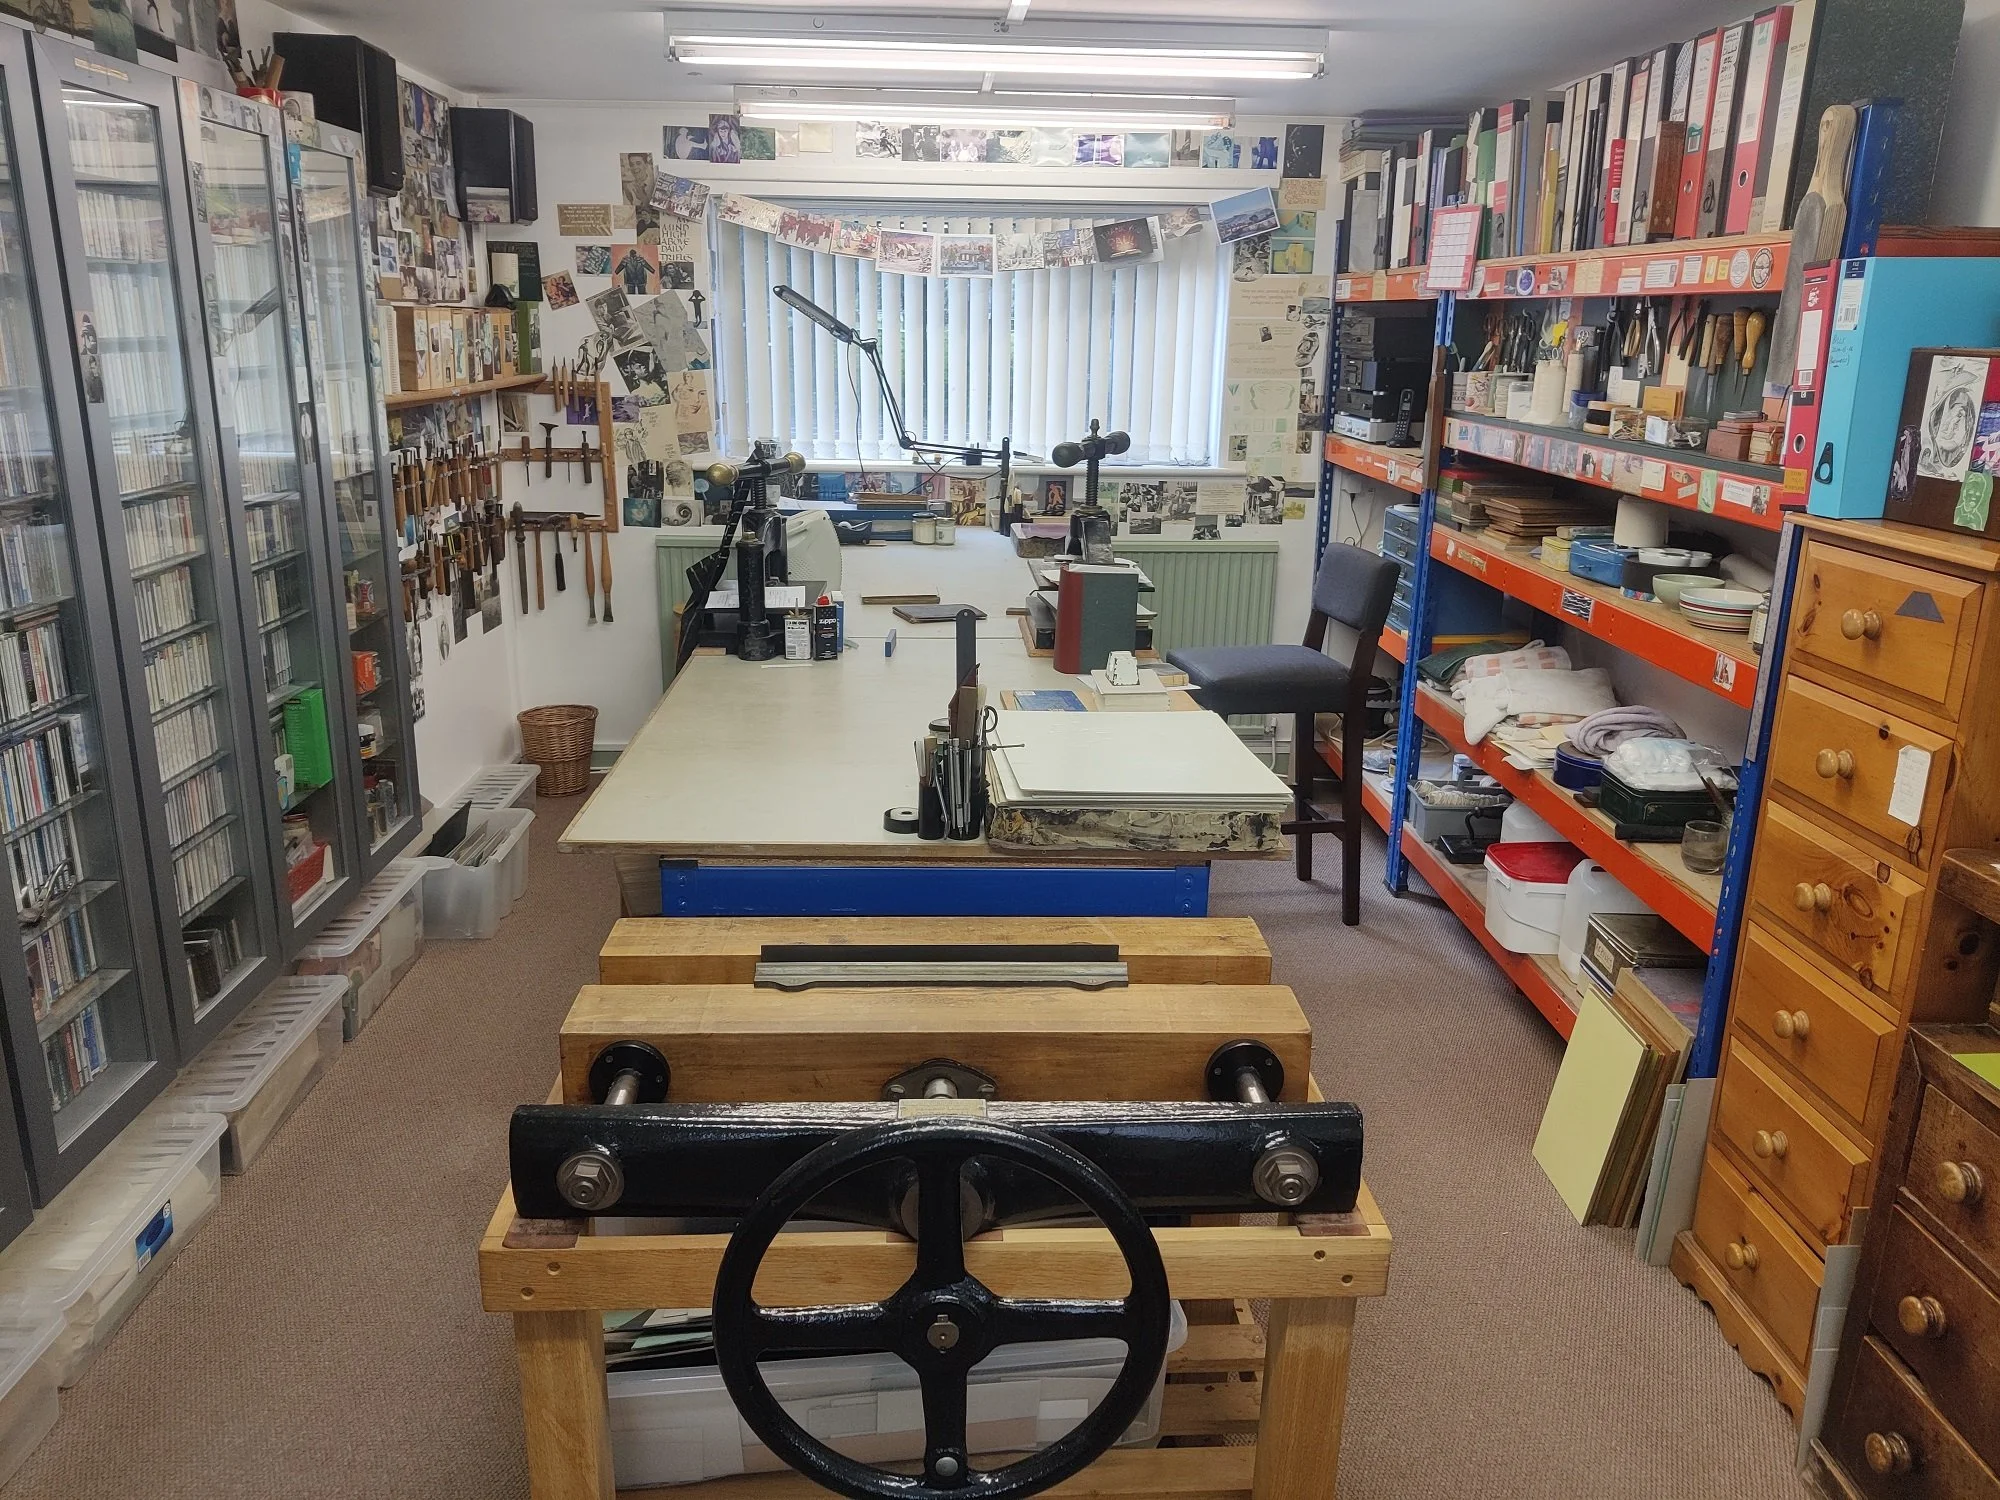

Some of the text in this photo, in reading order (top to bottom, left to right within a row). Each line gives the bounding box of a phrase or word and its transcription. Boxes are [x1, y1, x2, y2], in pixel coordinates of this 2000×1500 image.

[662, 230, 687, 238] HIGH
[662, 238, 689, 246] ABOVE
[661, 245, 686, 253] DAILY
